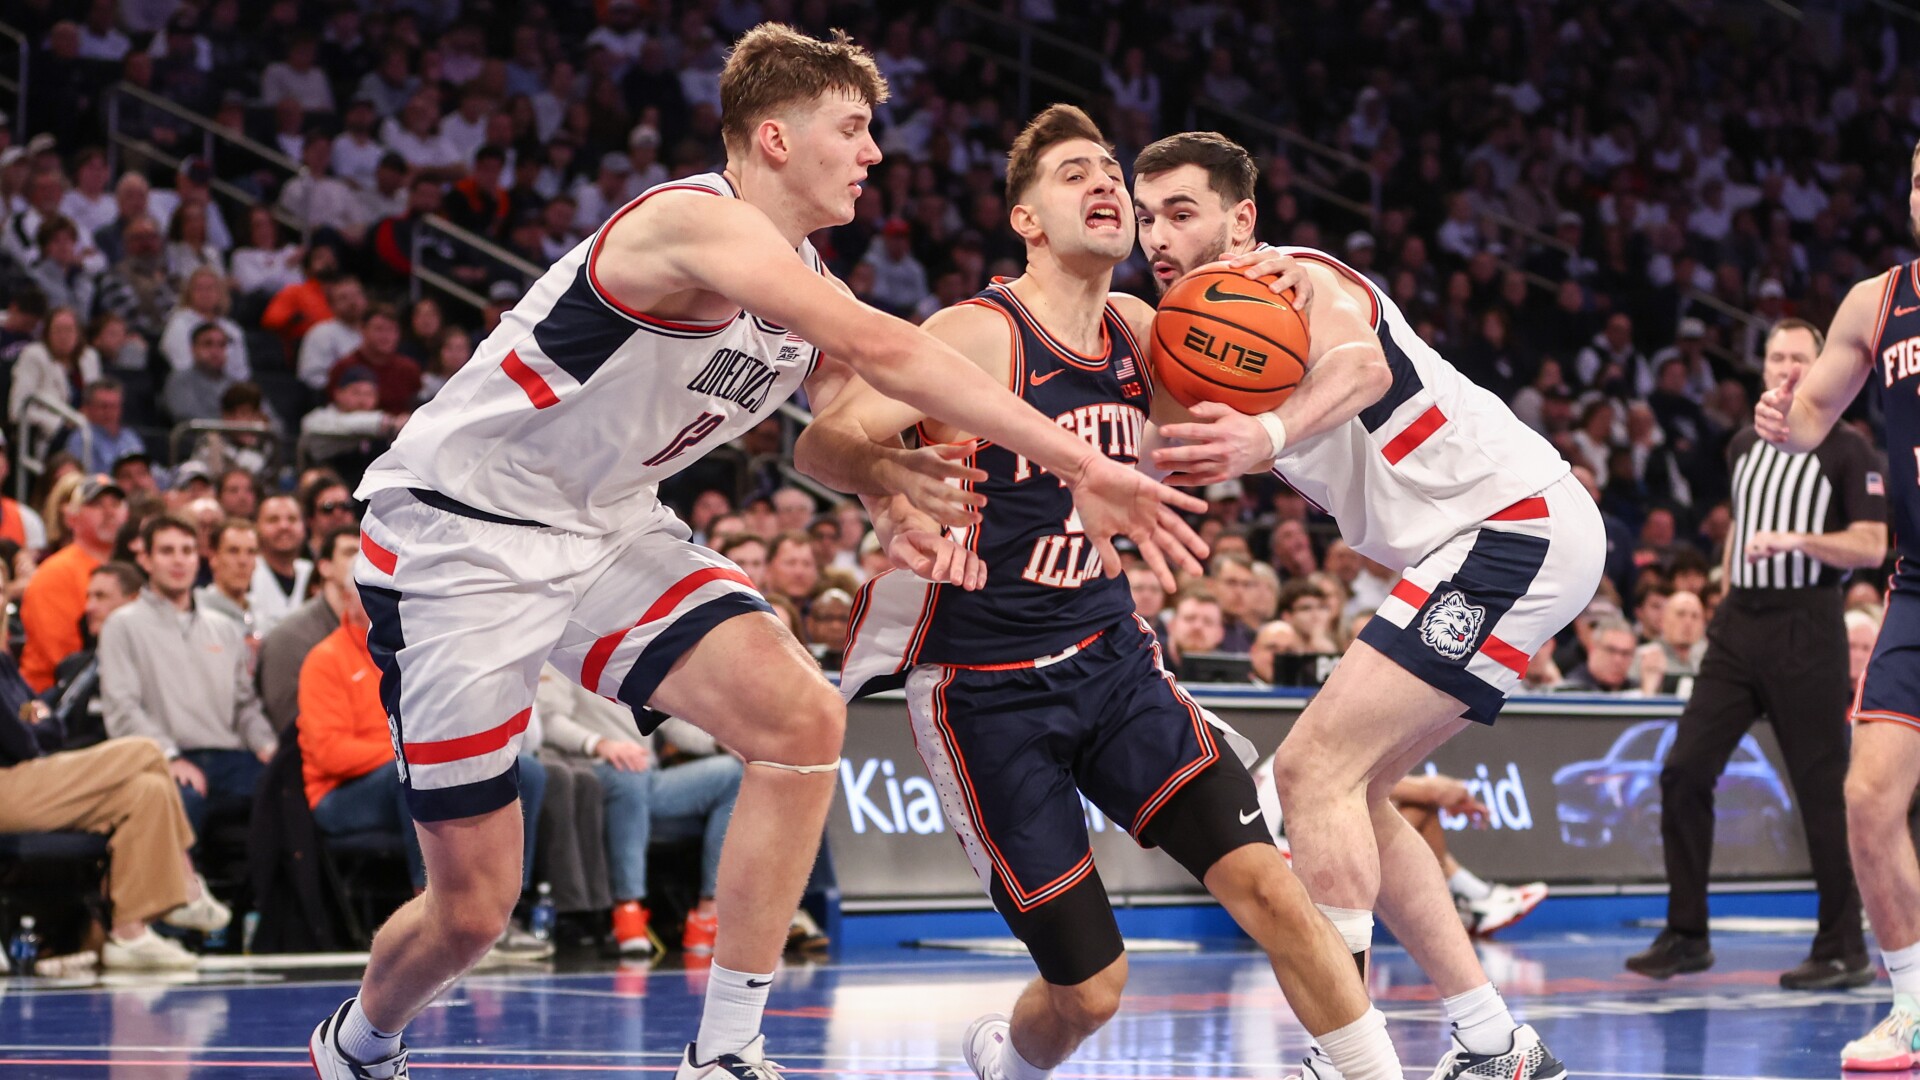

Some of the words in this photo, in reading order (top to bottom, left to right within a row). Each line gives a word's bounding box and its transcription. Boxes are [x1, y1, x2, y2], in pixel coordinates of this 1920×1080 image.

[1183, 326, 1269, 375] ELITE
[641, 411, 725, 466] 12
[840, 757, 945, 835] Kia
